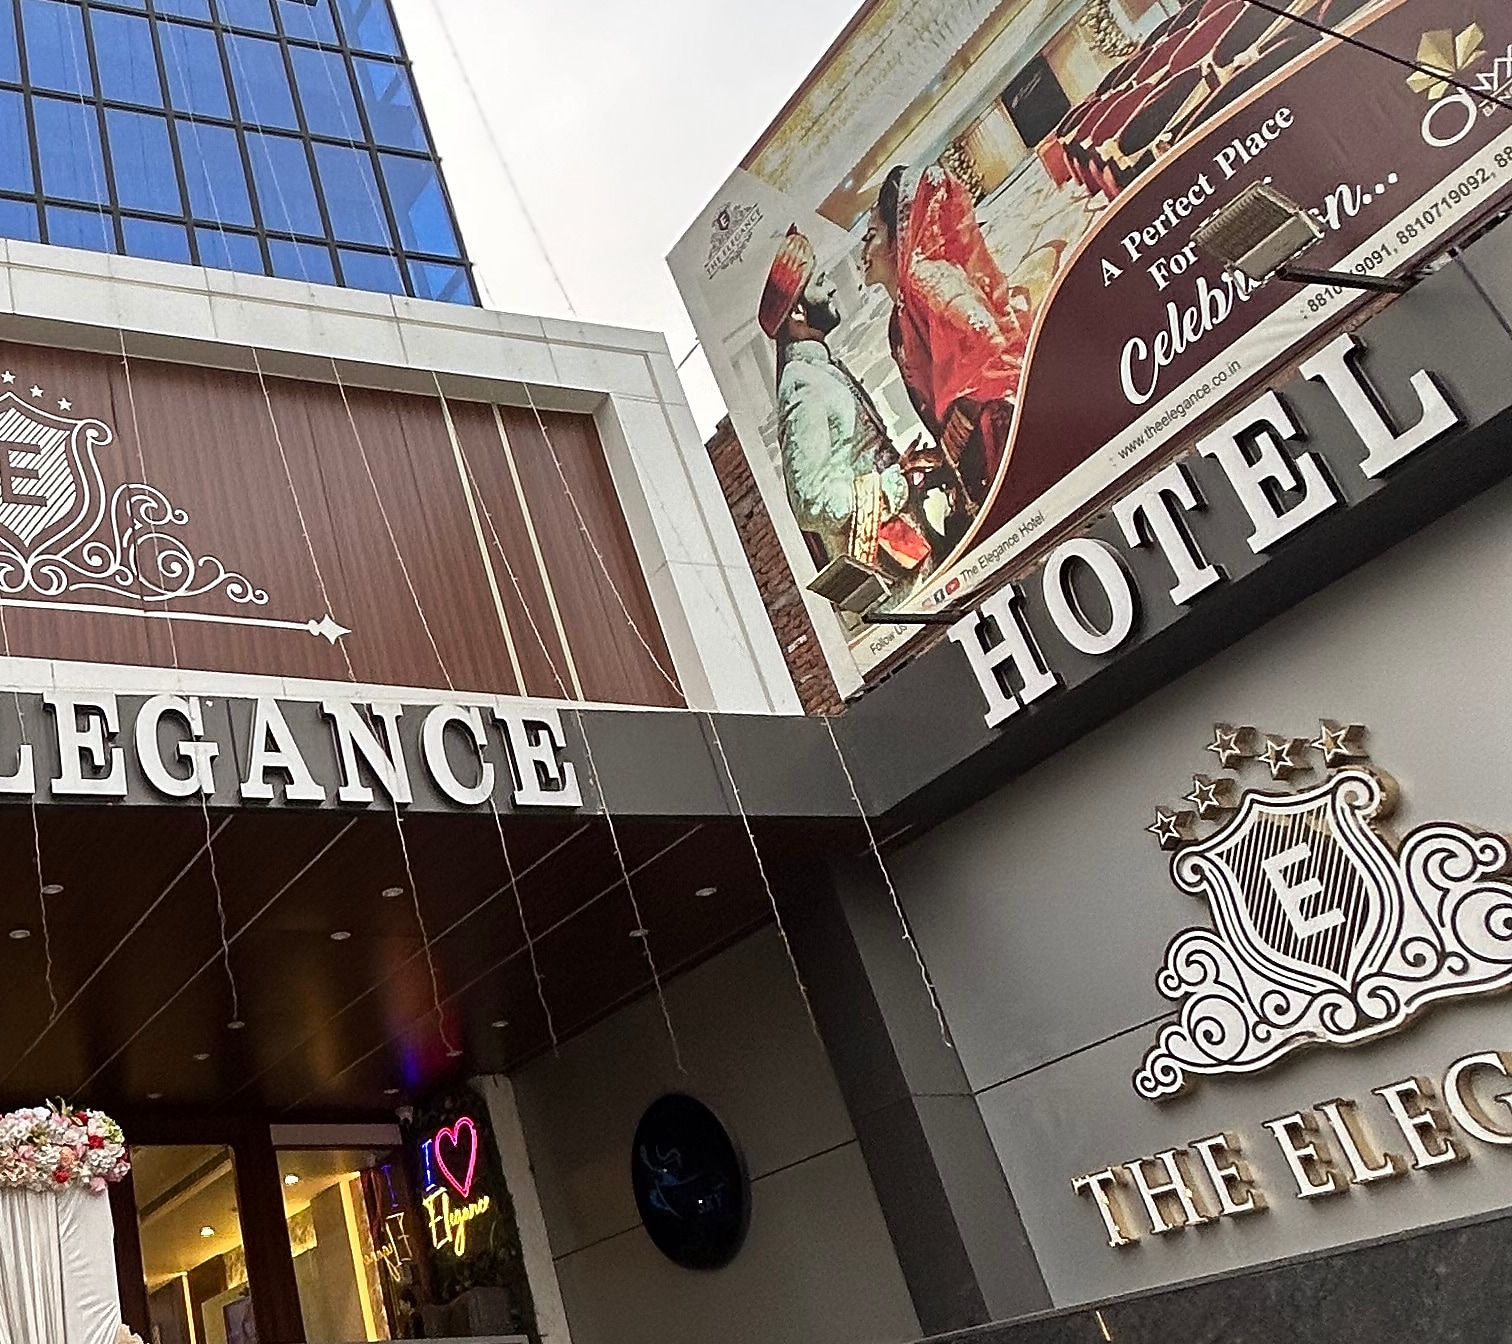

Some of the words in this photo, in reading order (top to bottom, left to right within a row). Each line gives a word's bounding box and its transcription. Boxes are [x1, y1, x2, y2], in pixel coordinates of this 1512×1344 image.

[721, 207, 762, 258] ELEGANCE
[1097, 258, 1124, 287] A
[1120, 172, 1216, 263] Perfect
[1212, 106, 1295, 181] Place
[1306, 243, 1399, 313] 88109091,
[1395, 166, 1497, 246] 8810719092,
[1146, 240, 1201, 292] For
[1117, 359, 1242, 460] www.theelegance.co.in
[946, 332, 1461, 730] HOTEL
[959, 564, 979, 583] The
[977, 533, 1020, 570] Elegance
[1017, 509, 1046, 537] Hotel
[869, 631, 896, 656] Follow
[1262, 841, 1347, 940] E
[1070, 1133, 1263, 1248] THE
